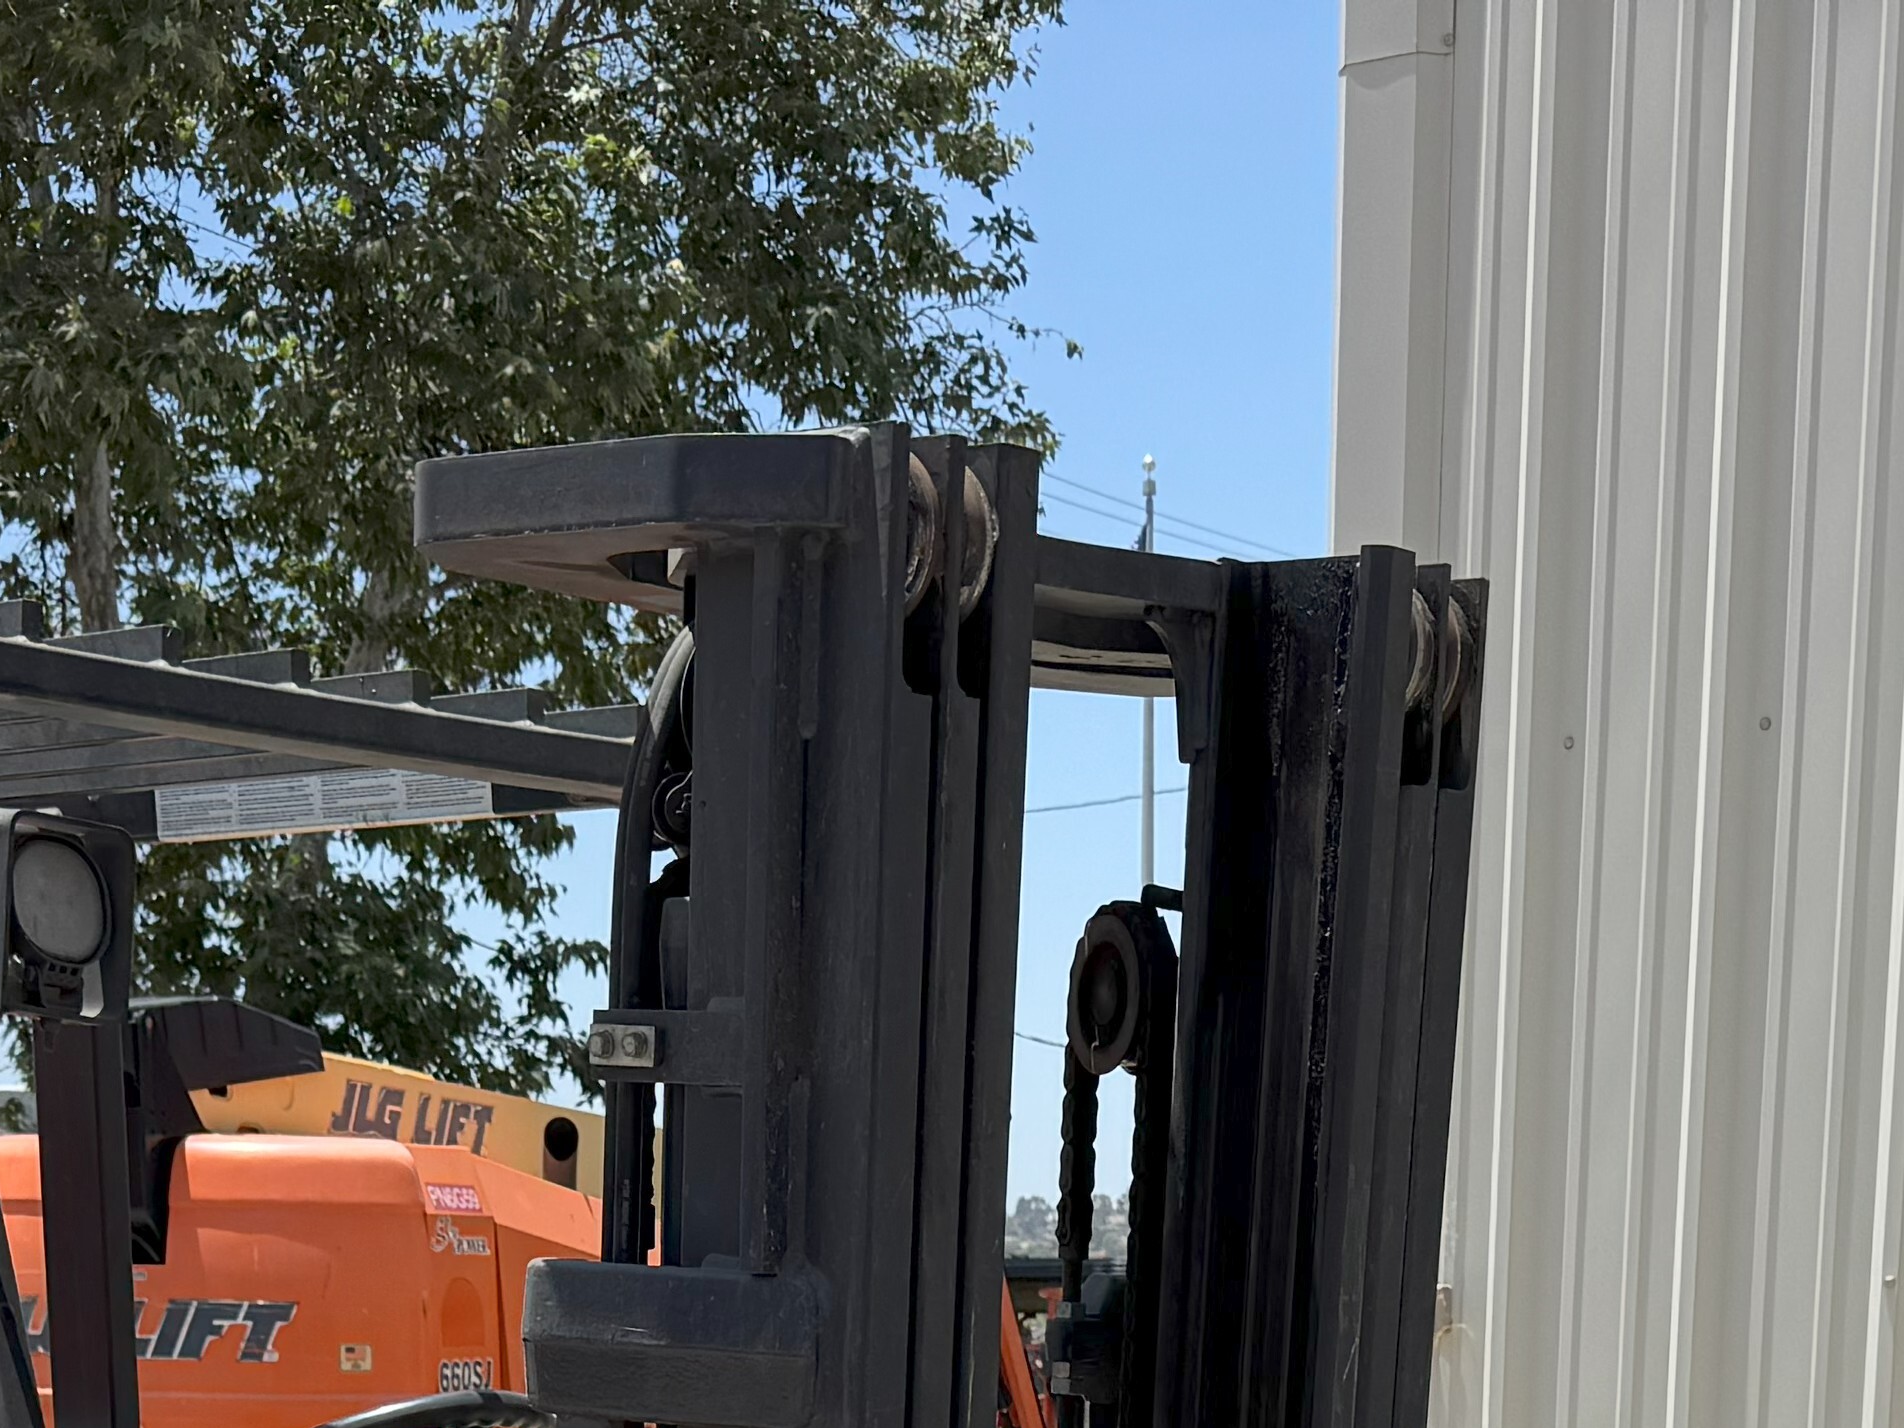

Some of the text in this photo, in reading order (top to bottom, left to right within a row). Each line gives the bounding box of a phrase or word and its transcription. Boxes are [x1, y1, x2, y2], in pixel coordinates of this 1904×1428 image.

[329, 1078, 495, 1157] JLG LIFT
[439, 1359, 493, 1392] 660SJ
